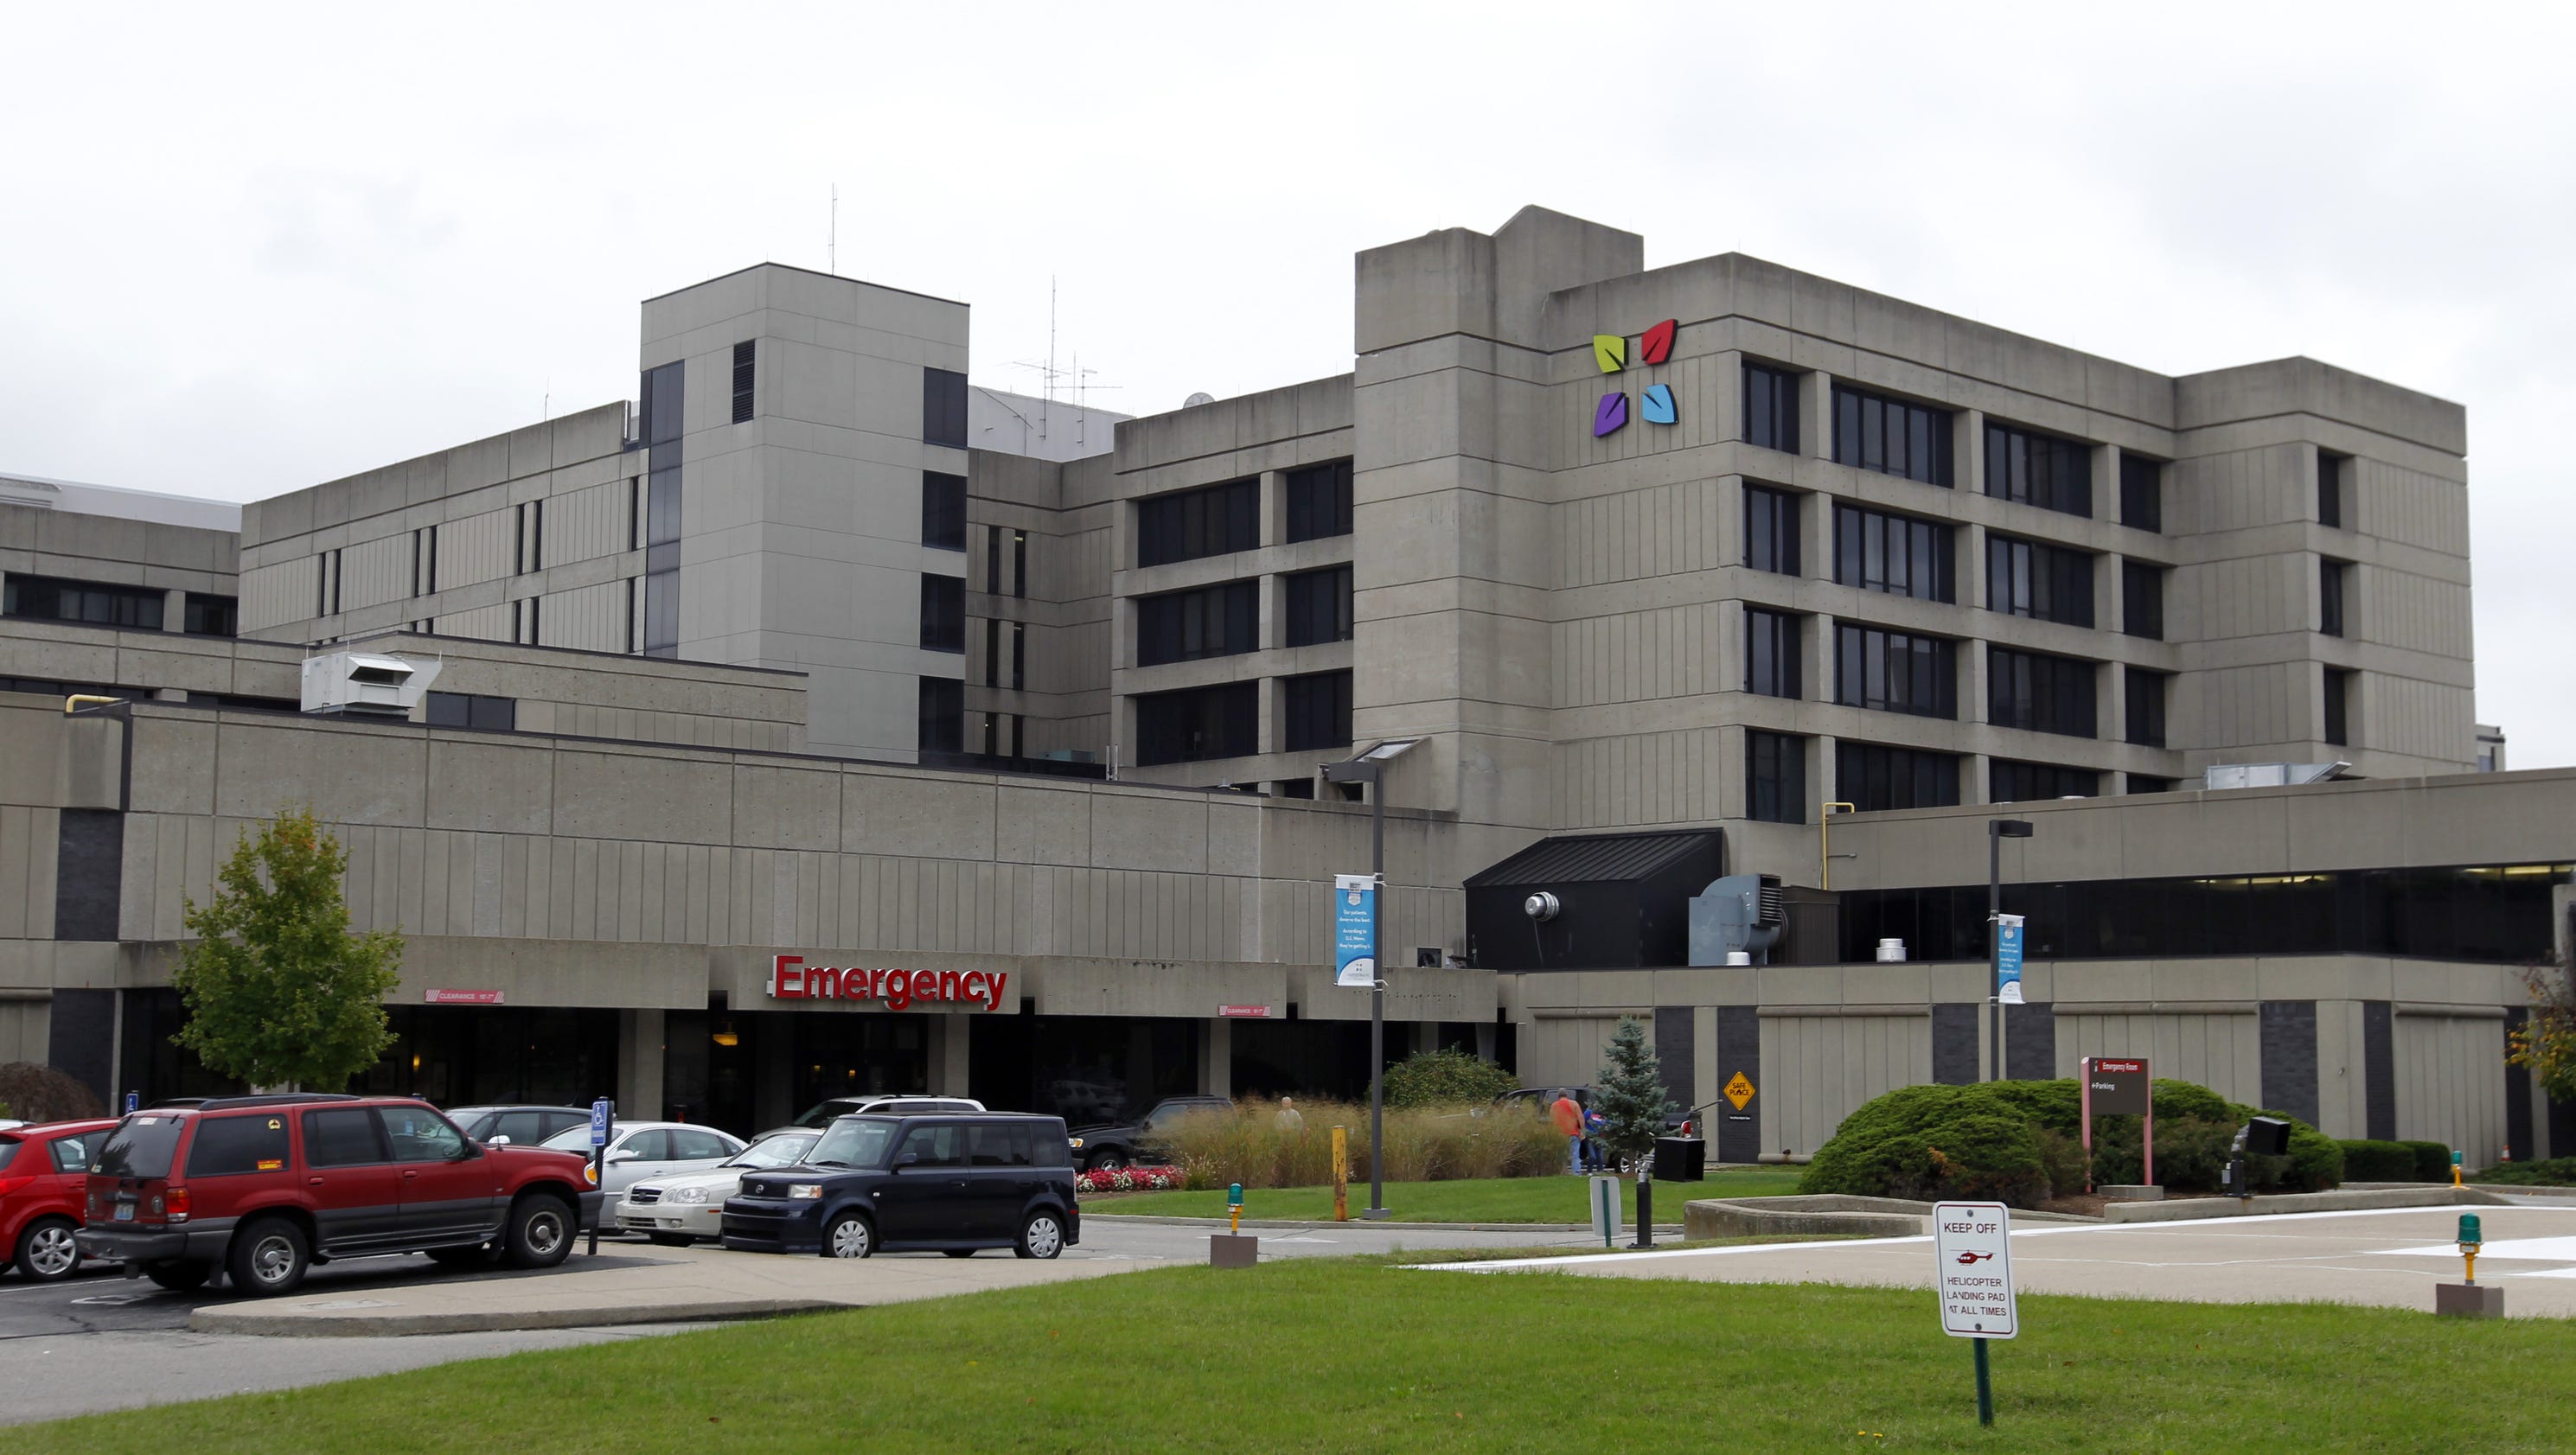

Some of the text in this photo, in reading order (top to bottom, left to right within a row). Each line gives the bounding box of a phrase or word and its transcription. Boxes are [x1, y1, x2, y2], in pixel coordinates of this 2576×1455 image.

[773, 954, 1007, 1011] Emergency
[2102, 1062, 2138, 1072] Emergency Room
[2095, 1082, 2115, 1091] Parking
[1944, 1222, 1998, 1234] KEEP OFF
[1947, 1276, 2003, 1287] HELICOPTER
[1946, 1291, 2006, 1302] LANDING PAD
[1960, 1305, 1978, 1315] ALL
[1980, 1306, 2007, 1317] TIMES
